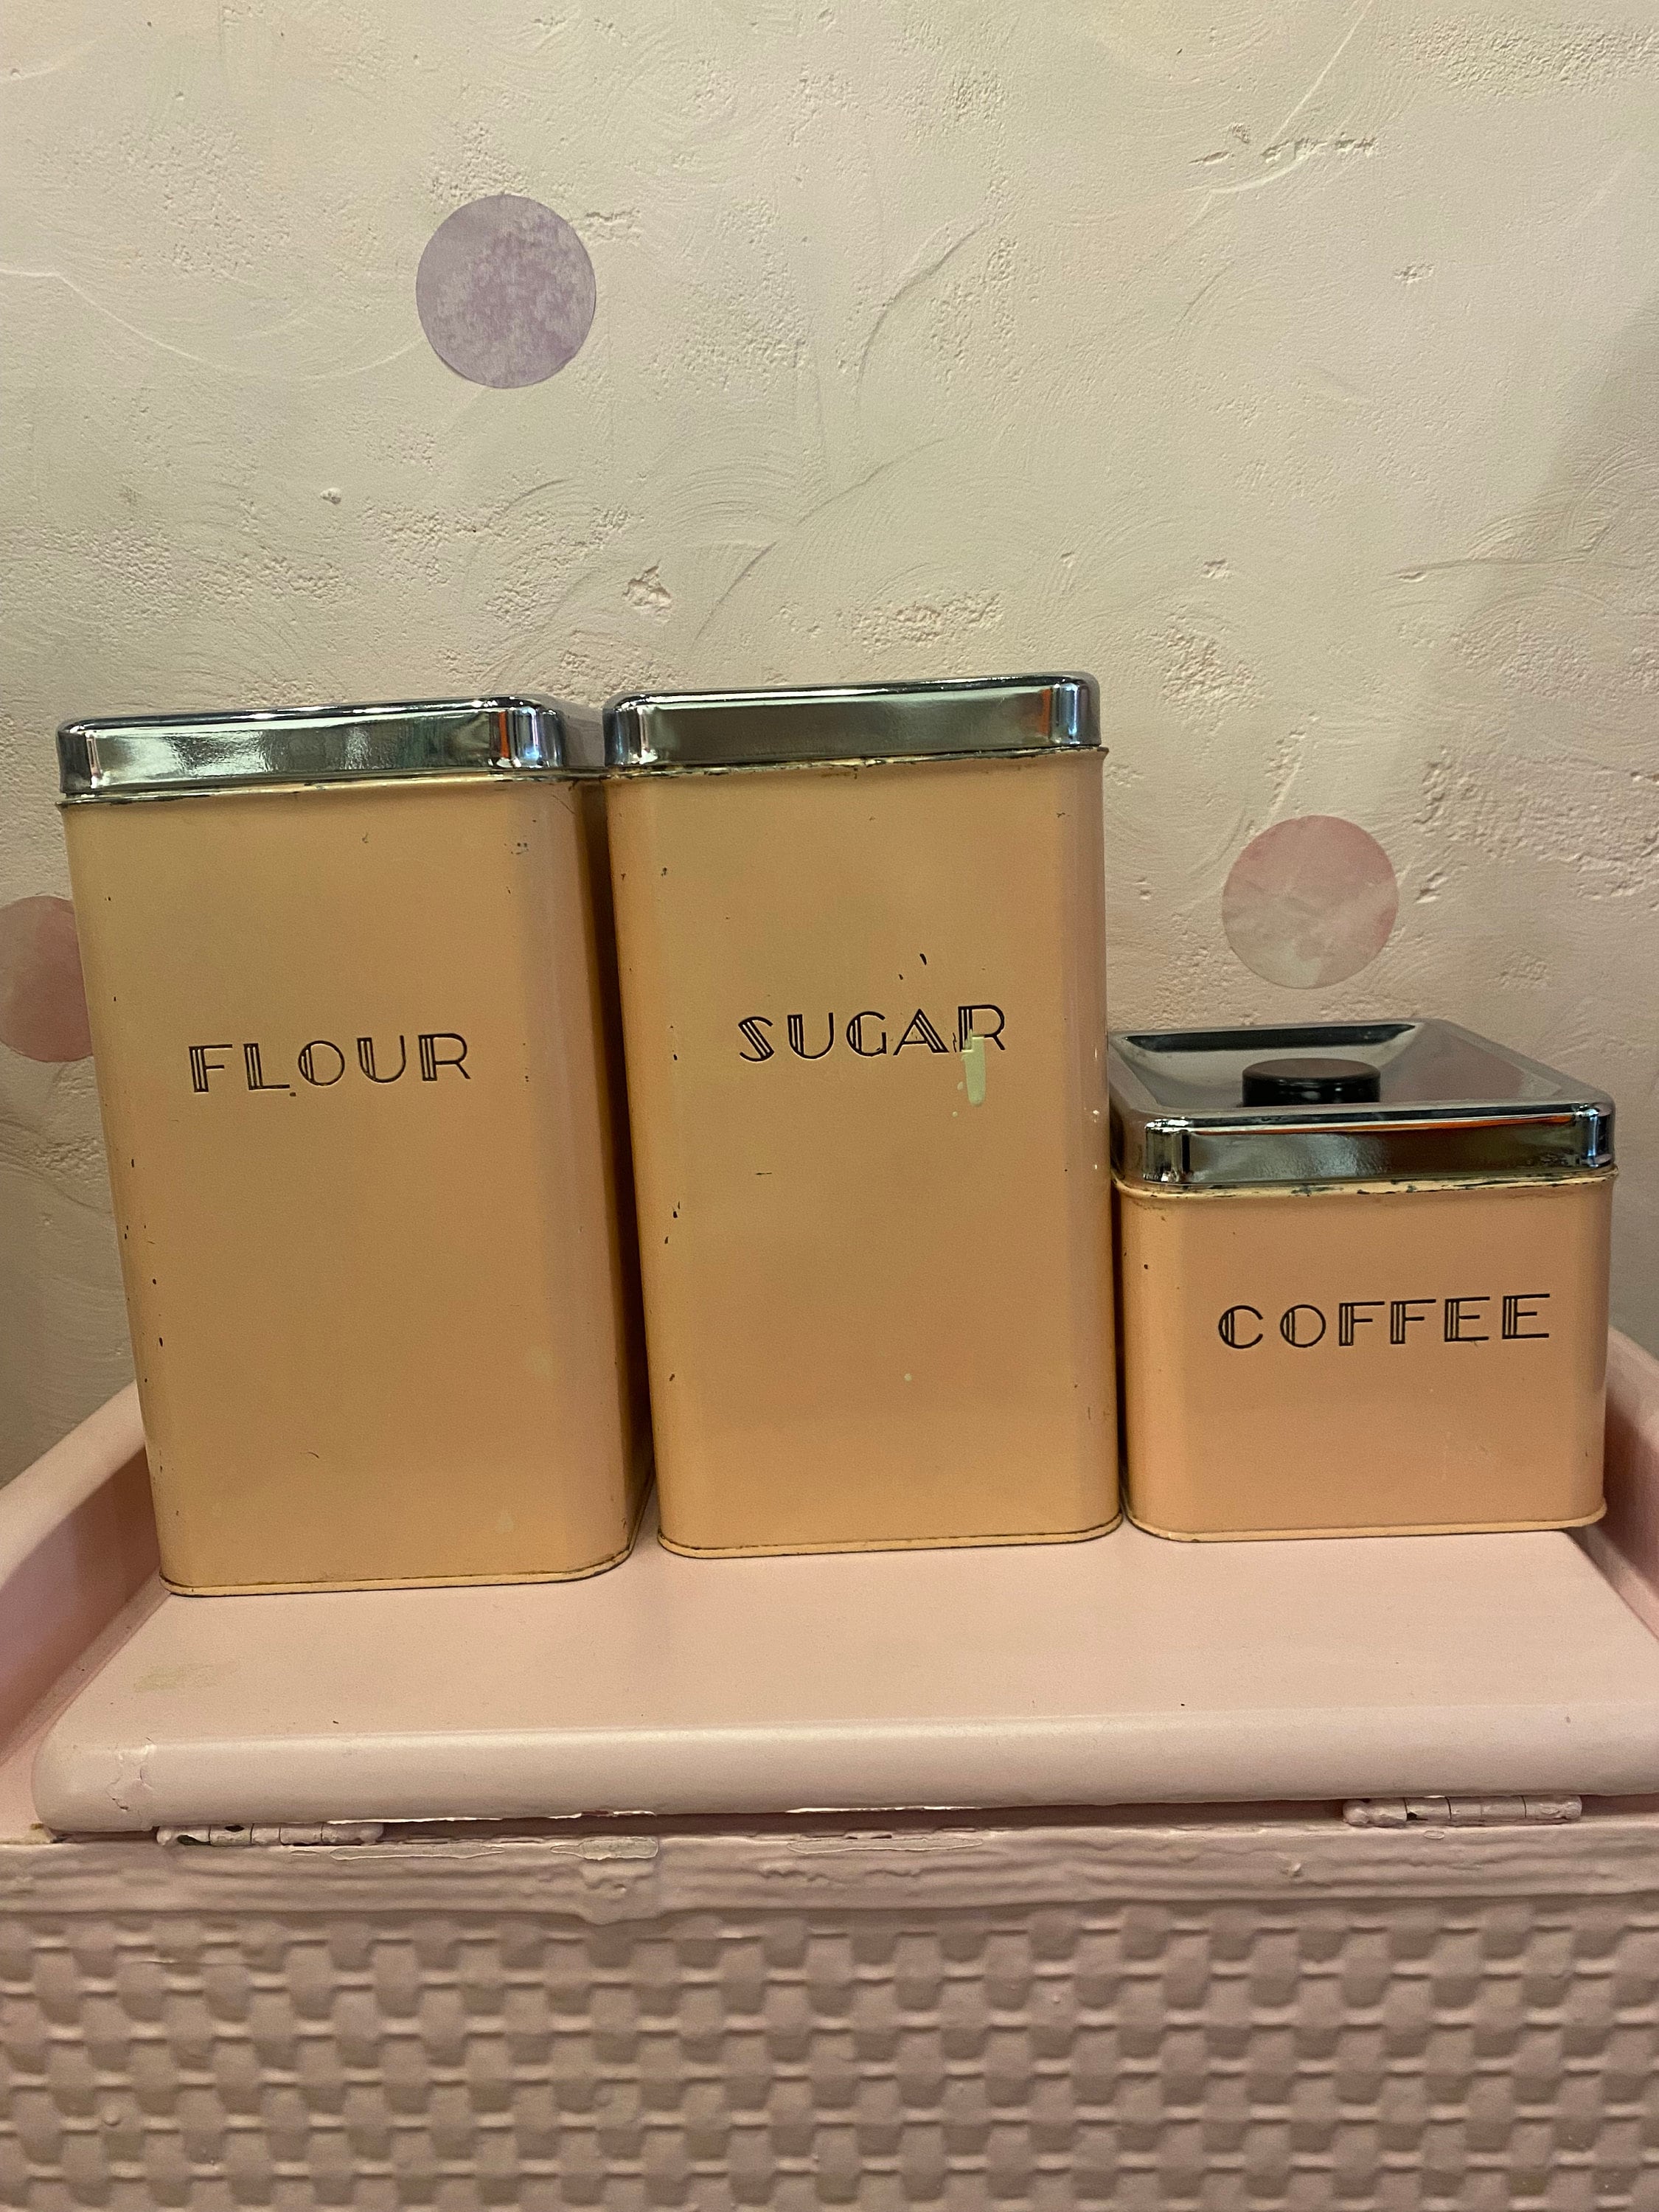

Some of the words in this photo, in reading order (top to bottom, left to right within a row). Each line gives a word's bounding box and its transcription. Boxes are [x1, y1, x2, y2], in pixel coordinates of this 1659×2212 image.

[737, 1004, 1006, 1062] SUGAR
[188, 1032, 471, 1093] FLOUR
[1217, 1293, 1551, 1349] COFFEE
